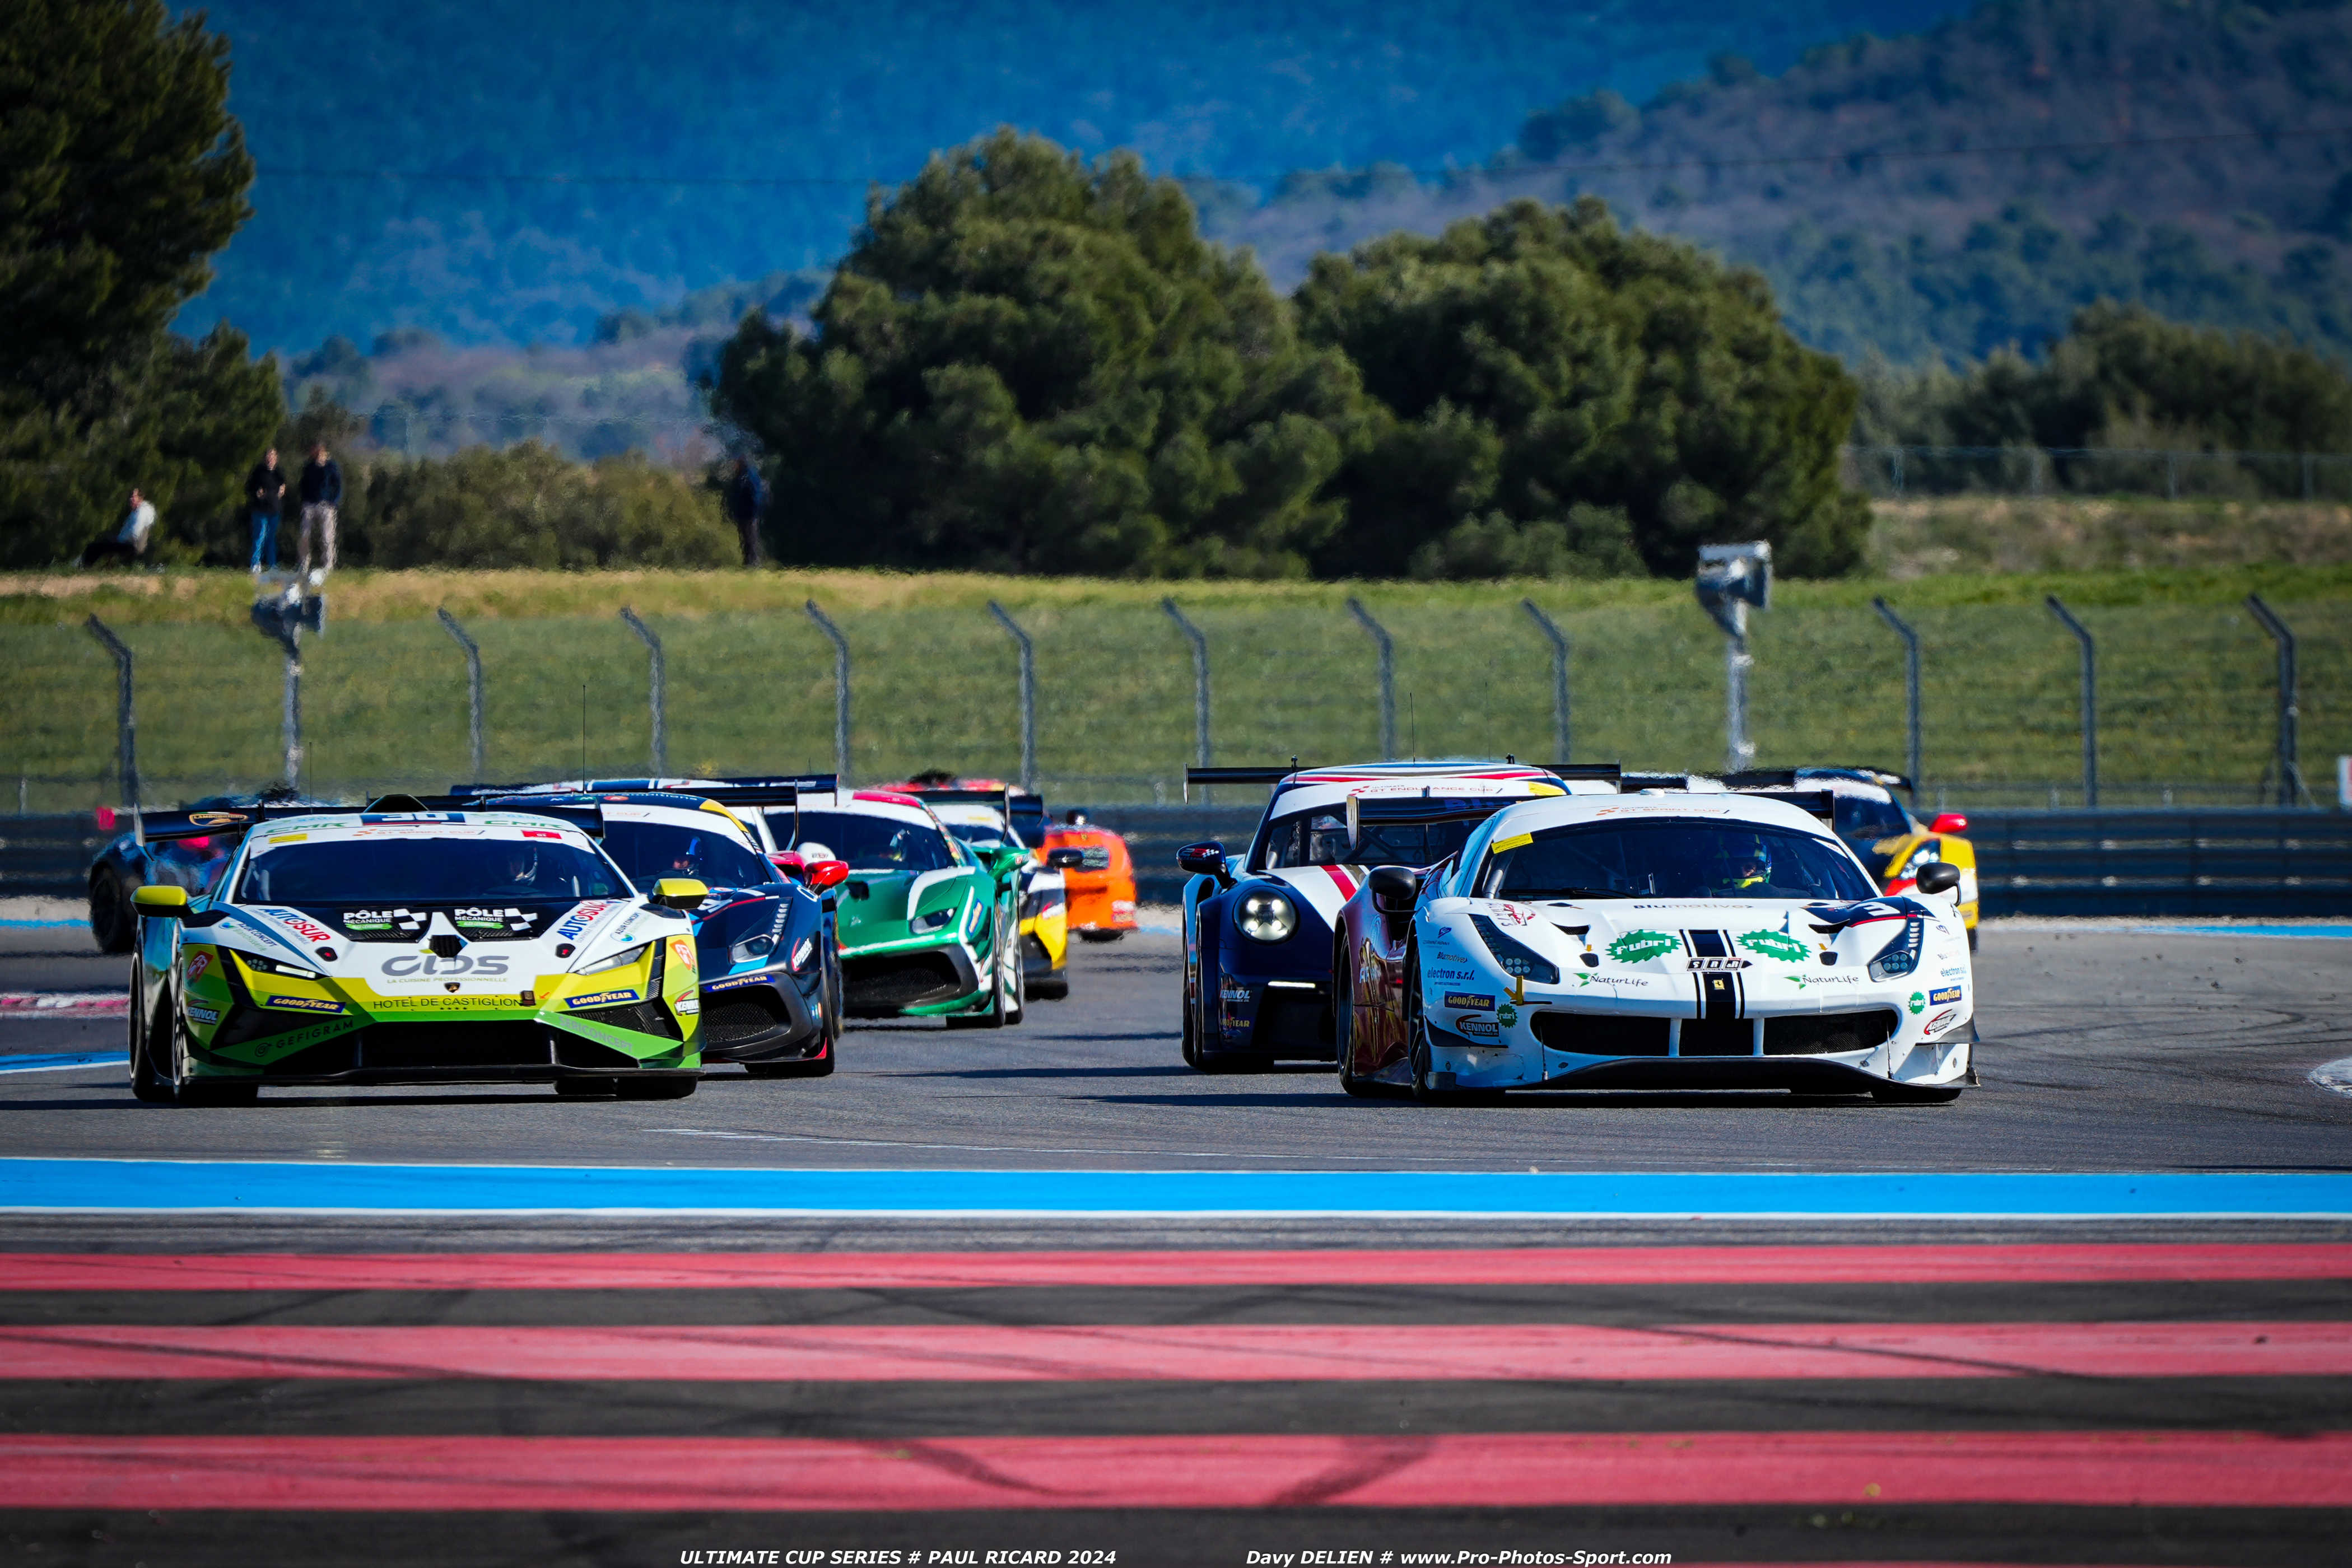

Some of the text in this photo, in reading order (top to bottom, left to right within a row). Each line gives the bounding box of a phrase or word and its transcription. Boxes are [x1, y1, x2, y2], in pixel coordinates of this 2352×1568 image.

[266, 822, 349, 834] CMR
[484, 819, 566, 829] CMR
[343, 909, 393, 920] PÔLE
[454, 907, 504, 917] PÔLE
[258, 909, 331, 942] AUTOSUR
[557, 900, 609, 941] AUTOSUR
[250, 928, 277, 946] CONCEPT
[1427, 967, 1455, 979] electron
[1590, 975, 1648, 987] NaturLife
[1803, 976, 1859, 984] NaturLife
[572, 992, 632, 1006] GOODYEAR
[1933, 987, 1960, 1002] GOODYEAR
[273, 998, 339, 1010] GOODYEAR
[373, 999, 414, 1009] HOTEL
[442, 997, 521, 1007] CASTIGLION
[1448, 995, 1491, 1007] GOODYEAR
[1459, 1021, 1498, 1032] KENNOL
[276, 1019, 354, 1049] GEFIGRAM
[558, 1016, 634, 1052] SERICONCEPT
